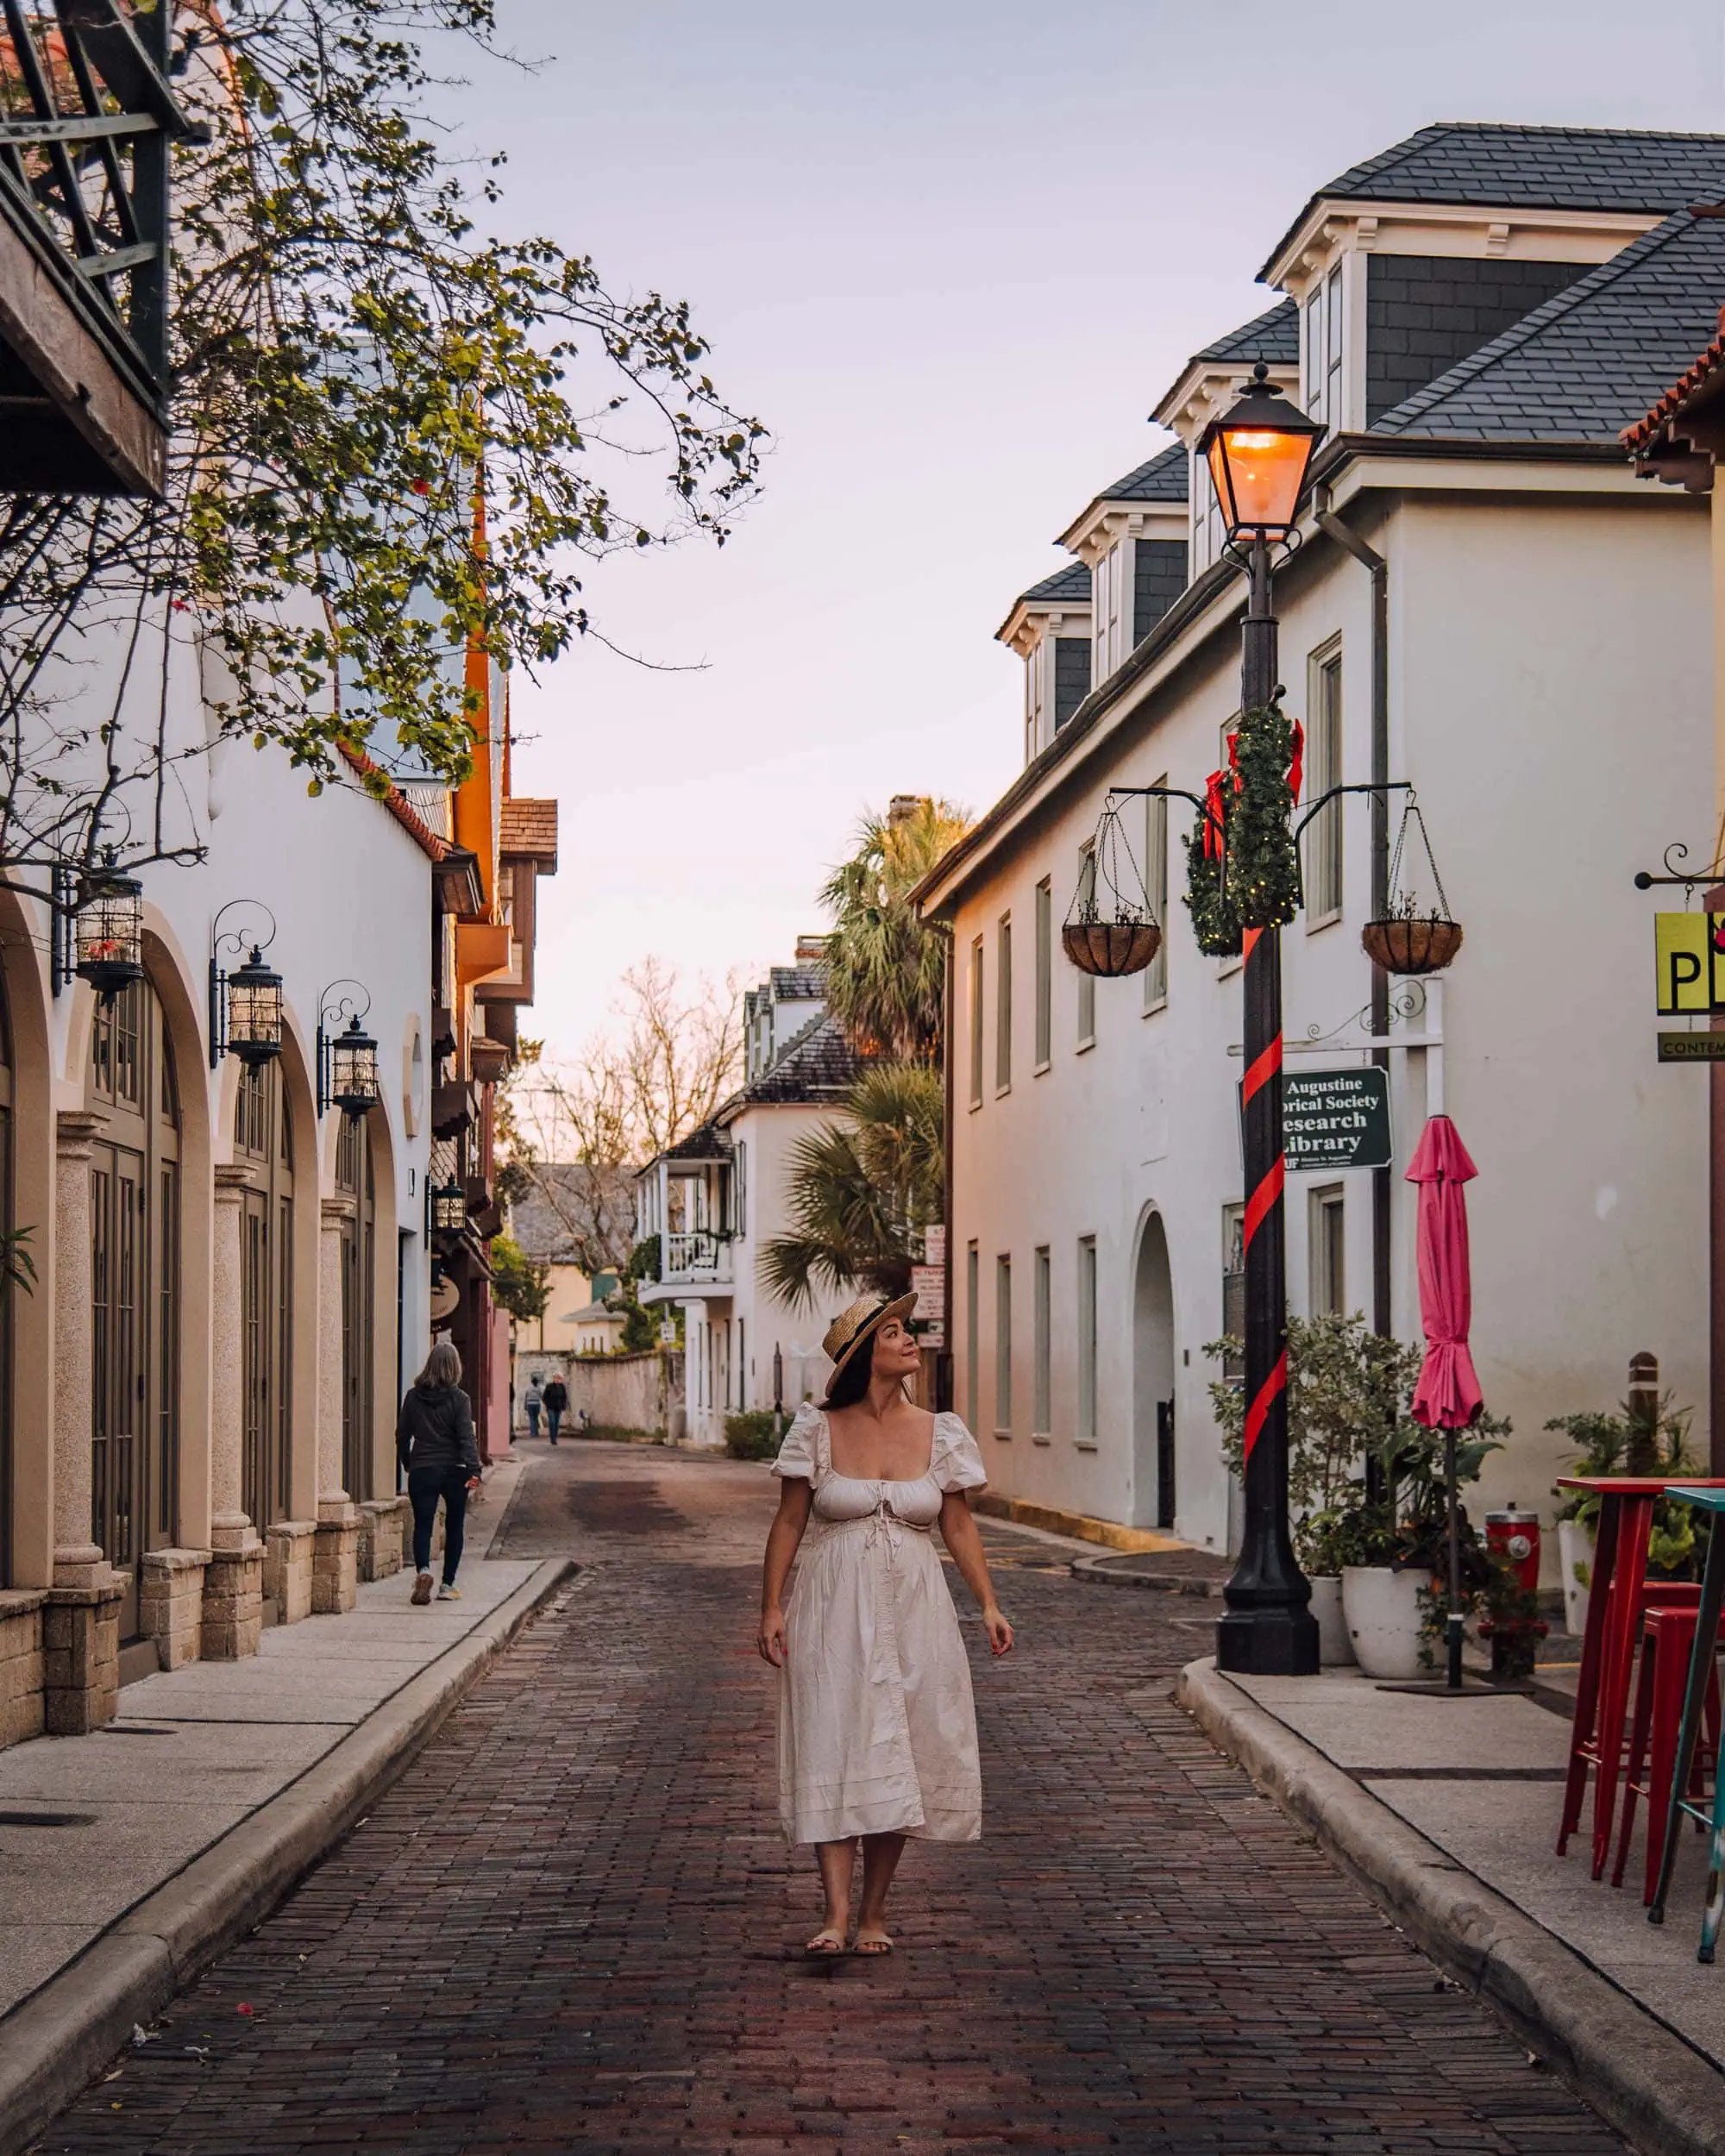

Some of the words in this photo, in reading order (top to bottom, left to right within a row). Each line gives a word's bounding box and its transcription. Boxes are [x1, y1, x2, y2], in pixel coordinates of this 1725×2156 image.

[1287, 1077, 1363, 1096] Augustine
[1326, 1094, 1379, 1110] Society
[1283, 1112, 1367, 1132] esearch
